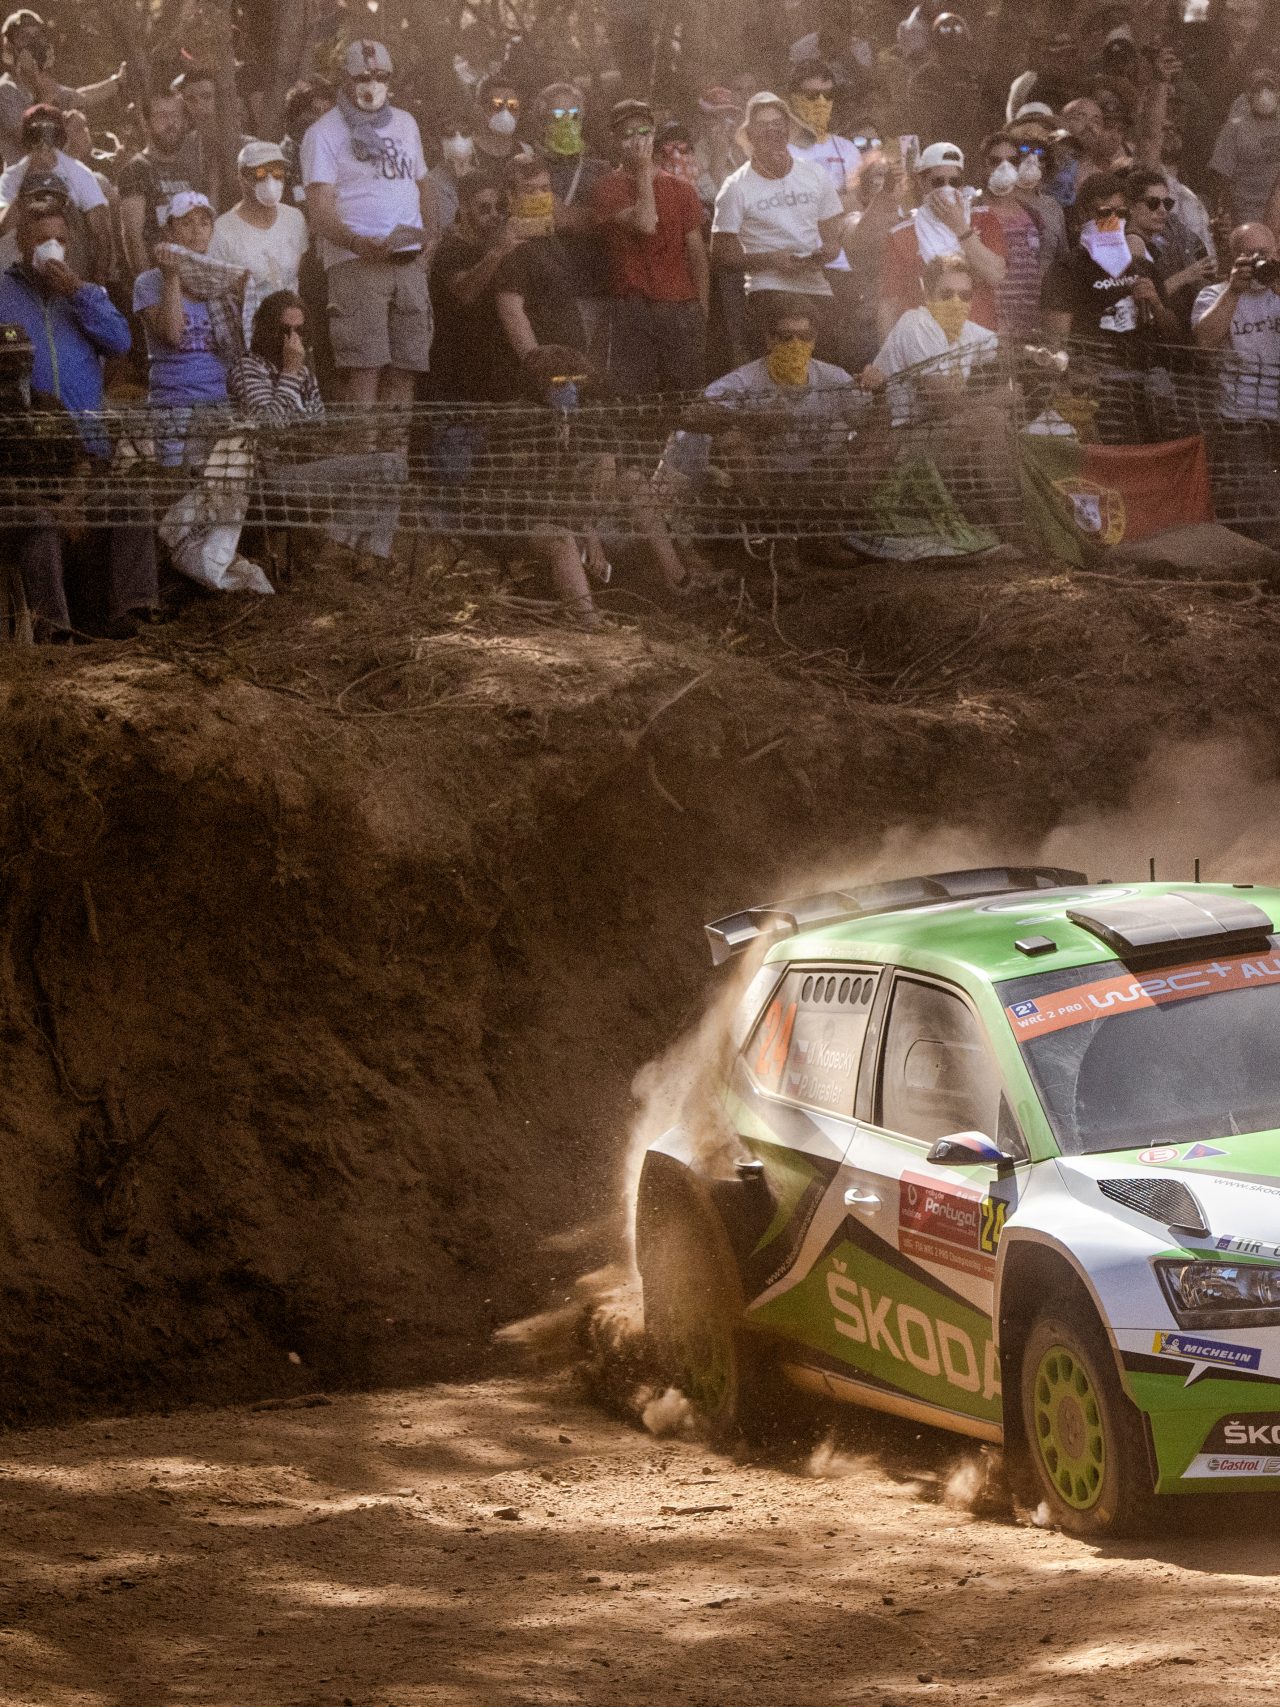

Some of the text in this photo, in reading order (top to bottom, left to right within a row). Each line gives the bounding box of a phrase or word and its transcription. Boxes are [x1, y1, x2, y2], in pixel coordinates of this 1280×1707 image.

[1017, 1003, 1083, 1028] WRC 2 PRO
[1149, 1150, 1167, 1161] E
[925, 1197, 977, 1227] Portugal
[1183, 1344, 1252, 1363] MICHELIN
[1219, 1459, 1259, 1471] Castrol
